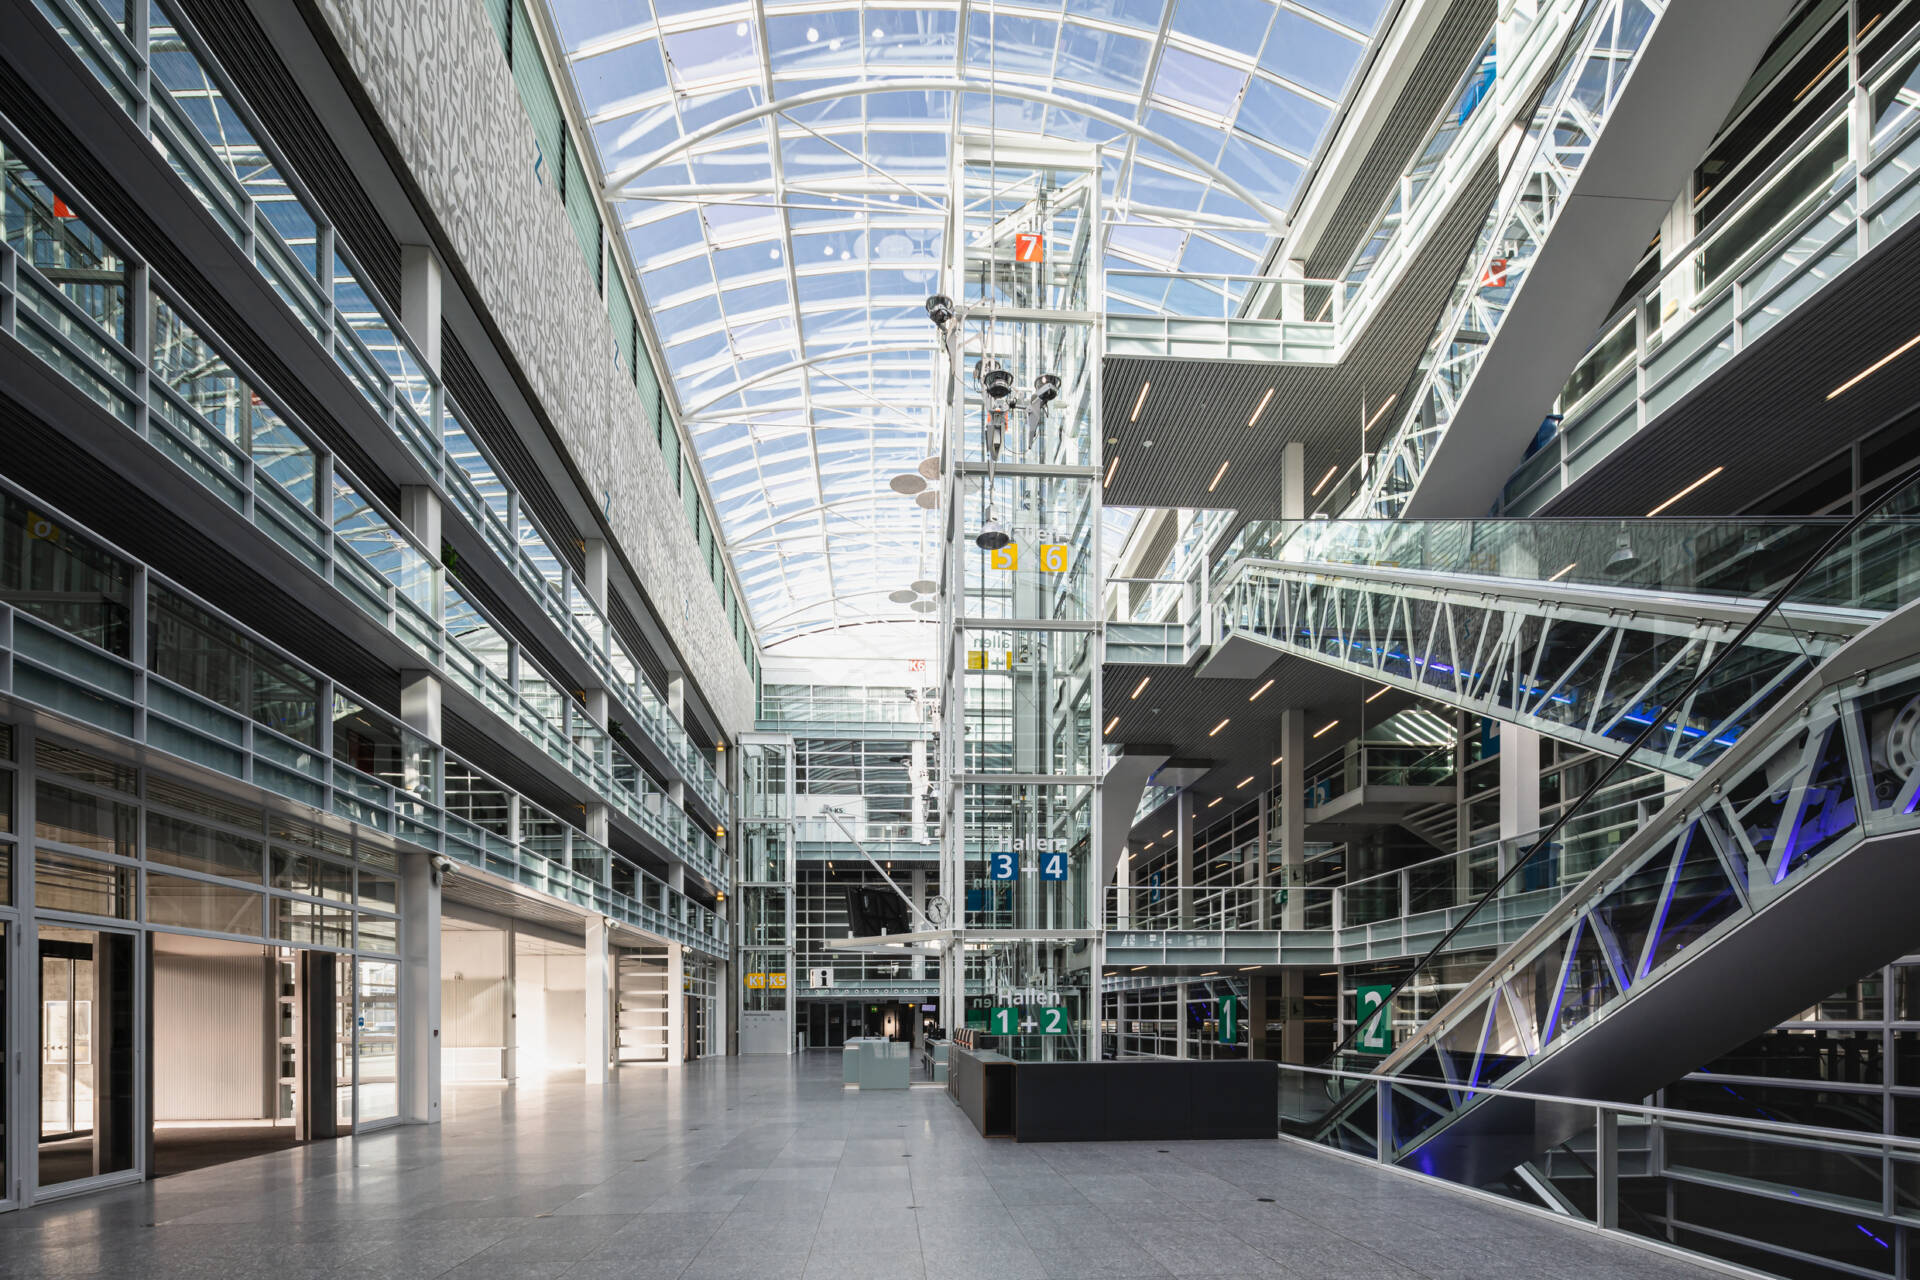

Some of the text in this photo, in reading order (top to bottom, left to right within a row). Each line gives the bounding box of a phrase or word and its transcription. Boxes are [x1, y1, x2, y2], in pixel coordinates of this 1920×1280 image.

[1021, 236, 1037, 259] 7
[998, 545, 1062, 570] 5 6
[910, 660, 926, 672] K6
[999, 833, 1061, 851] Hallen
[997, 854, 1012, 879] 3
[1045, 855, 1063, 879] 4
[999, 988, 1060, 1005] Hallen
[996, 1009, 1009, 1033] 1
[1045, 1009, 1062, 1033] 2
[1223, 999, 1231, 1040] 1
[1364, 991, 1384, 1048] 2
